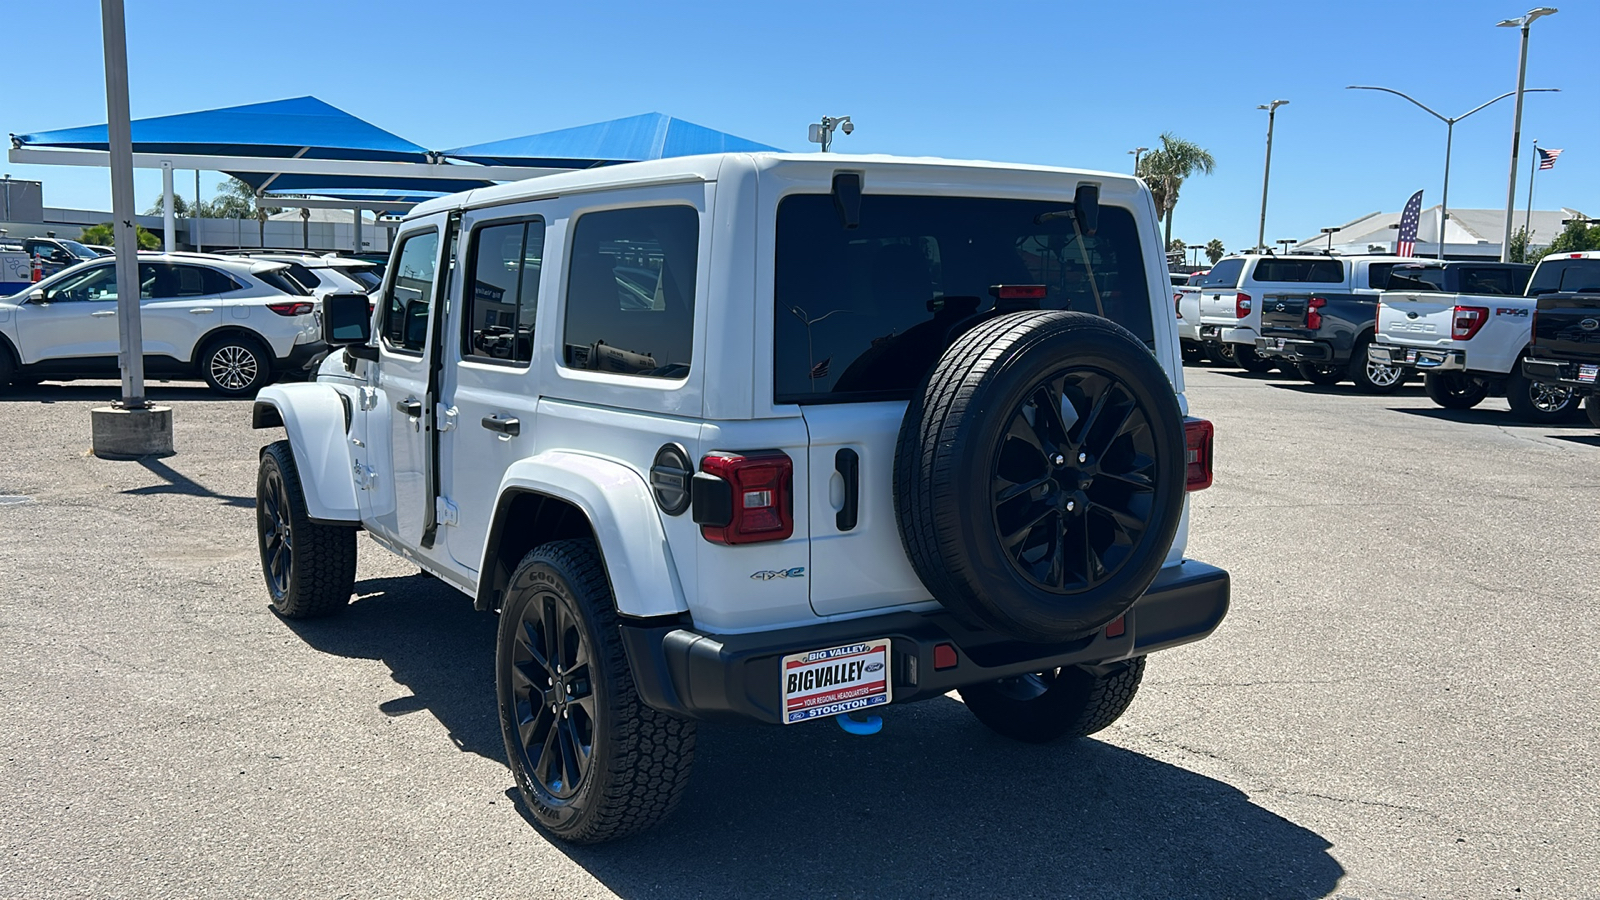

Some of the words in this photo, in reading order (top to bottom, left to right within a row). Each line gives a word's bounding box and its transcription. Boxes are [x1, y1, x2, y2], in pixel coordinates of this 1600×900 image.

[1496, 308, 1528, 317] FX4
[1389, 321, 1438, 334] F-150
[809, 651, 827, 661] BIG
[829, 644, 866, 657] VALLEY
[804, 698, 816, 707] YOUR
[816, 694, 837, 705] REGIONAL
[837, 687, 869, 699] HEADQUARTERS
[809, 699, 867, 717] STOCKTON
